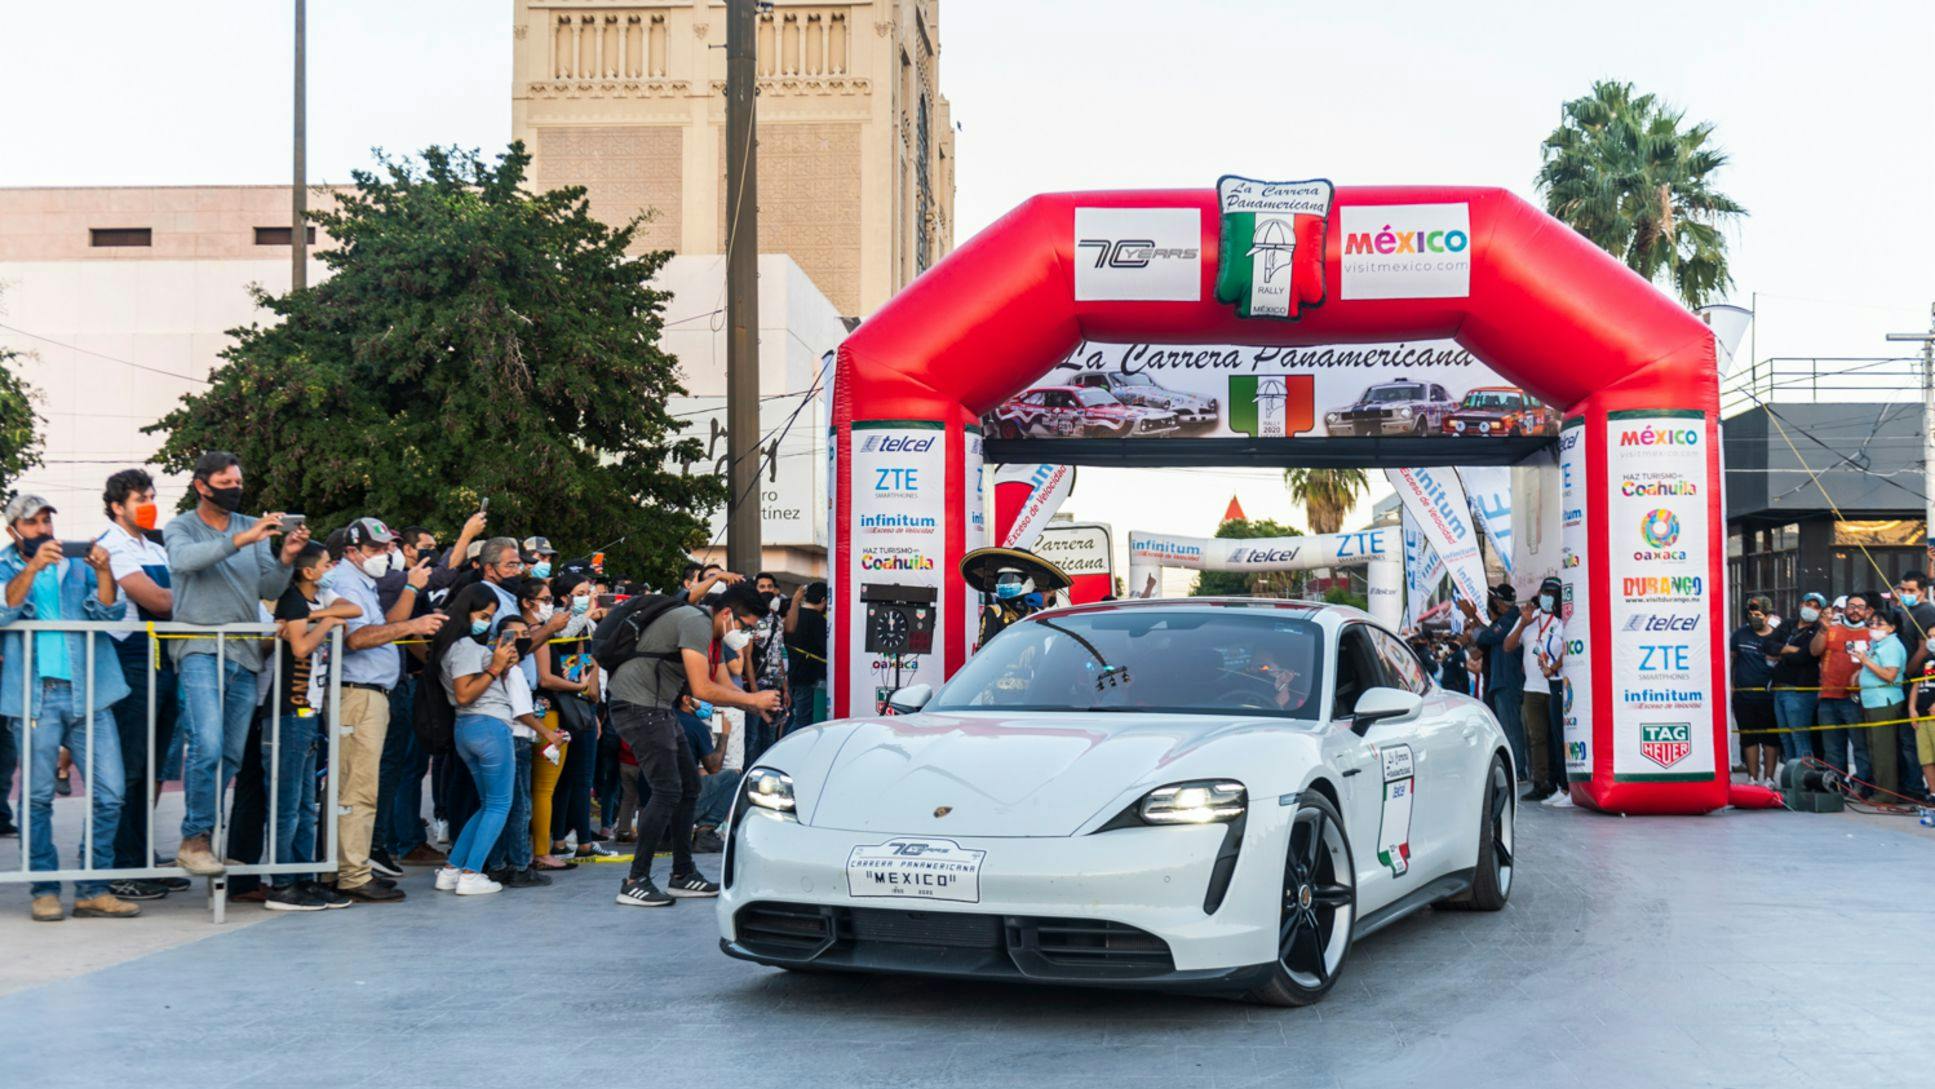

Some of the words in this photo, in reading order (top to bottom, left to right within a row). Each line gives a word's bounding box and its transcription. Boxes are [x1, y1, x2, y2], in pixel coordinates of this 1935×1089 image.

[1230, 182, 1252, 194] La
[1261, 185, 1319, 198] Carrera
[1227, 194, 1325, 212] Panamericana
[1078, 240, 1155, 268] 70
[1125, 248, 1199, 259] YEARS
[1344, 260, 1468, 273] visitmexico.com
[1258, 286, 1284, 294] RALLY
[1056, 341, 1106, 370] La
[1120, 344, 1242, 376] Carrera
[1251, 344, 1474, 371] Panamericana
[879, 435, 936, 452] telcel
[875, 468, 918, 490] ZTE
[1400, 467, 1422, 496] Exceso
[1642, 472, 1677, 480] TURISMO
[1621, 480, 1697, 497] Coahuila
[762, 507, 800, 520] tínez
[1008, 515, 1031, 546] Exceso
[1030, 503, 1040, 517] de
[1036, 464, 1067, 504] Velocidad
[861, 513, 935, 527] infinitum
[1132, 539, 1200, 555] infinitum
[1336, 531, 1385, 557] ZTE
[861, 554, 934, 570] Coahuila
[1246, 546, 1301, 563] telcel
[1633, 551, 1687, 561] oaxaca
[1623, 576, 1702, 596] DURANGO
[1645, 614, 1701, 631] telcel
[1638, 645, 1690, 671] ZTE
[1624, 689, 1702, 702] infinitum
[1645, 727, 1687, 740] TAG
[1644, 744, 1688, 766] HEUER
[850, 860, 893, 868] CARRERA
[900, 861, 976, 873] PANAMERICANA
